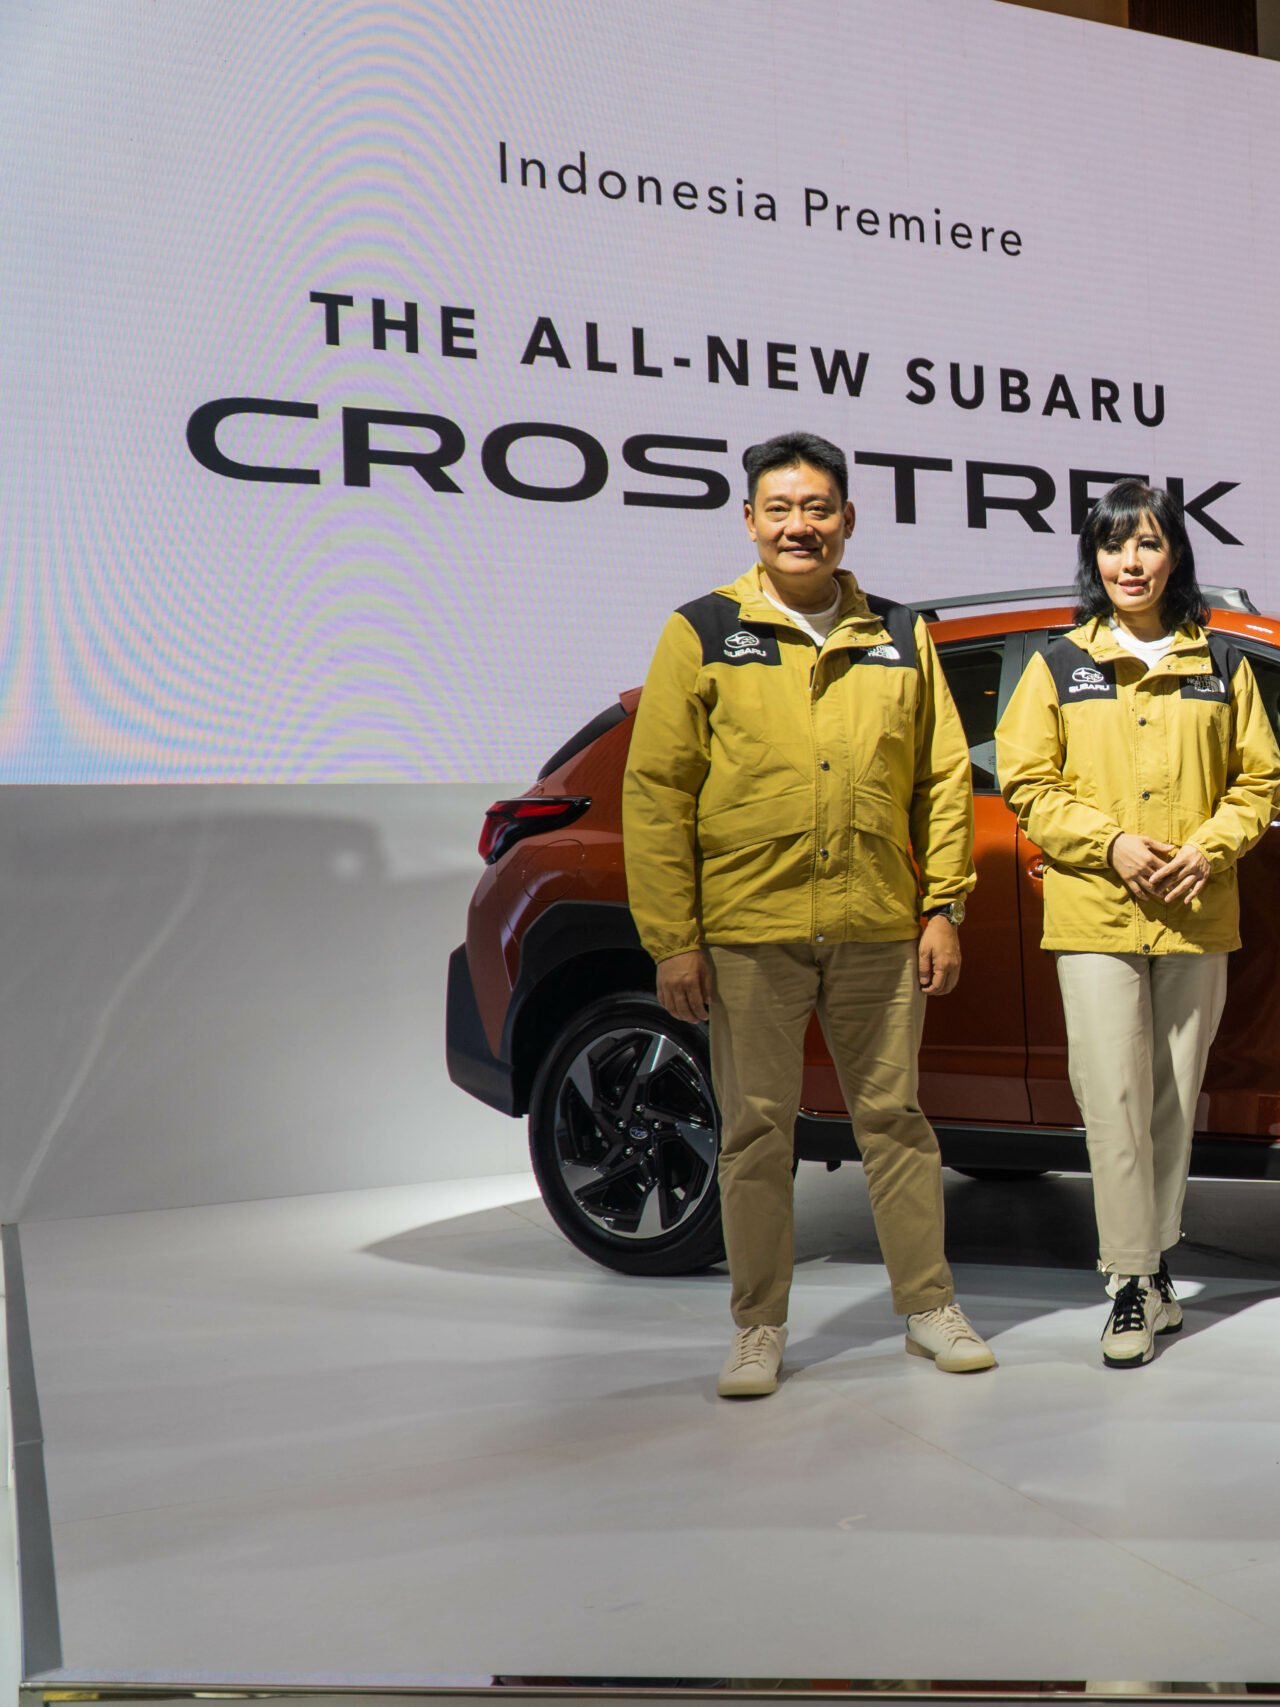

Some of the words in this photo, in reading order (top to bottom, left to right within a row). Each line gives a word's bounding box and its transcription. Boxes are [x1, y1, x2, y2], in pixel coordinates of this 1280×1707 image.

[499, 141, 778, 222] Indonesia
[804, 187, 1024, 257] Premiere
[309, 291, 478, 361] THE
[520, 316, 870, 398] ALL-NEW
[905, 357, 1165, 428] SUBARU
[186, 397, 1245, 546] CROSTREK
[723, 647, 767, 658] SUBARU
[1068, 683, 1110, 693] SUBARU
